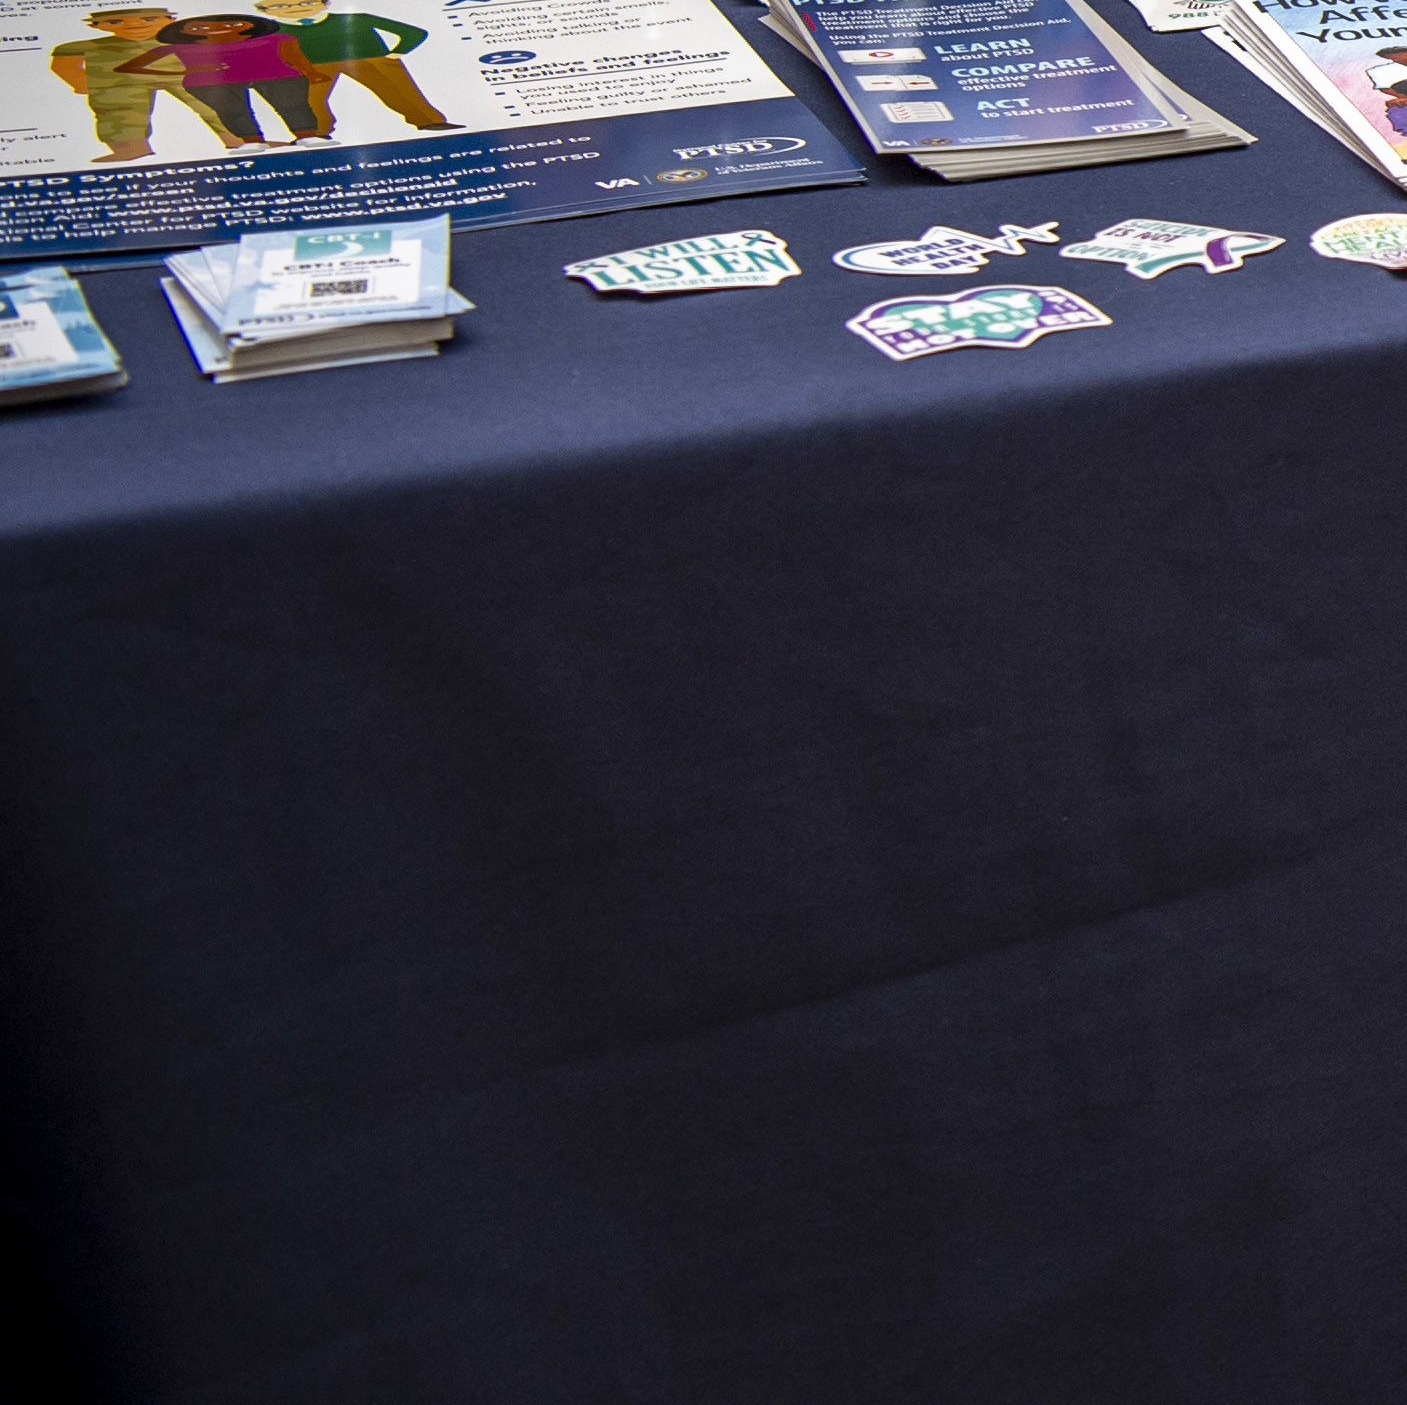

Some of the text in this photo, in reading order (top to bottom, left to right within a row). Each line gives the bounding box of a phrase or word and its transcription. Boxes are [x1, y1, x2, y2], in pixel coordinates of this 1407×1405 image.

[933, 37, 1033, 55] LEARN
[940, 46, 1036, 63] about PTSD
[480, 47, 683, 77] Negative changes
[485, 49, 731, 83] in beliefs and feelings
[951, 55, 1096, 78] COMPARE
[956, 63, 1119, 87] effective treatment
[961, 80, 1027, 93] options
[976, 97, 1031, 111] ACT
[980, 98, 1136, 120] to start treatment
[204, 135, 592, 185] thoughts and feelings are related to
[678, 141, 774, 161] PTSD
[79, 160, 256, 184] Symptoms?
[594, 177, 641, 190] VA
[606, 236, 740, 267] I WILL
[882, 236, 965, 258] WORLD
[888, 243, 985, 266] HEALTH
[598, 248, 793, 290] LISTEN
[933, 255, 978, 270] DAY
[861, 288, 1037, 334] STAY
[892, 307, 1096, 354] NOT OVER
